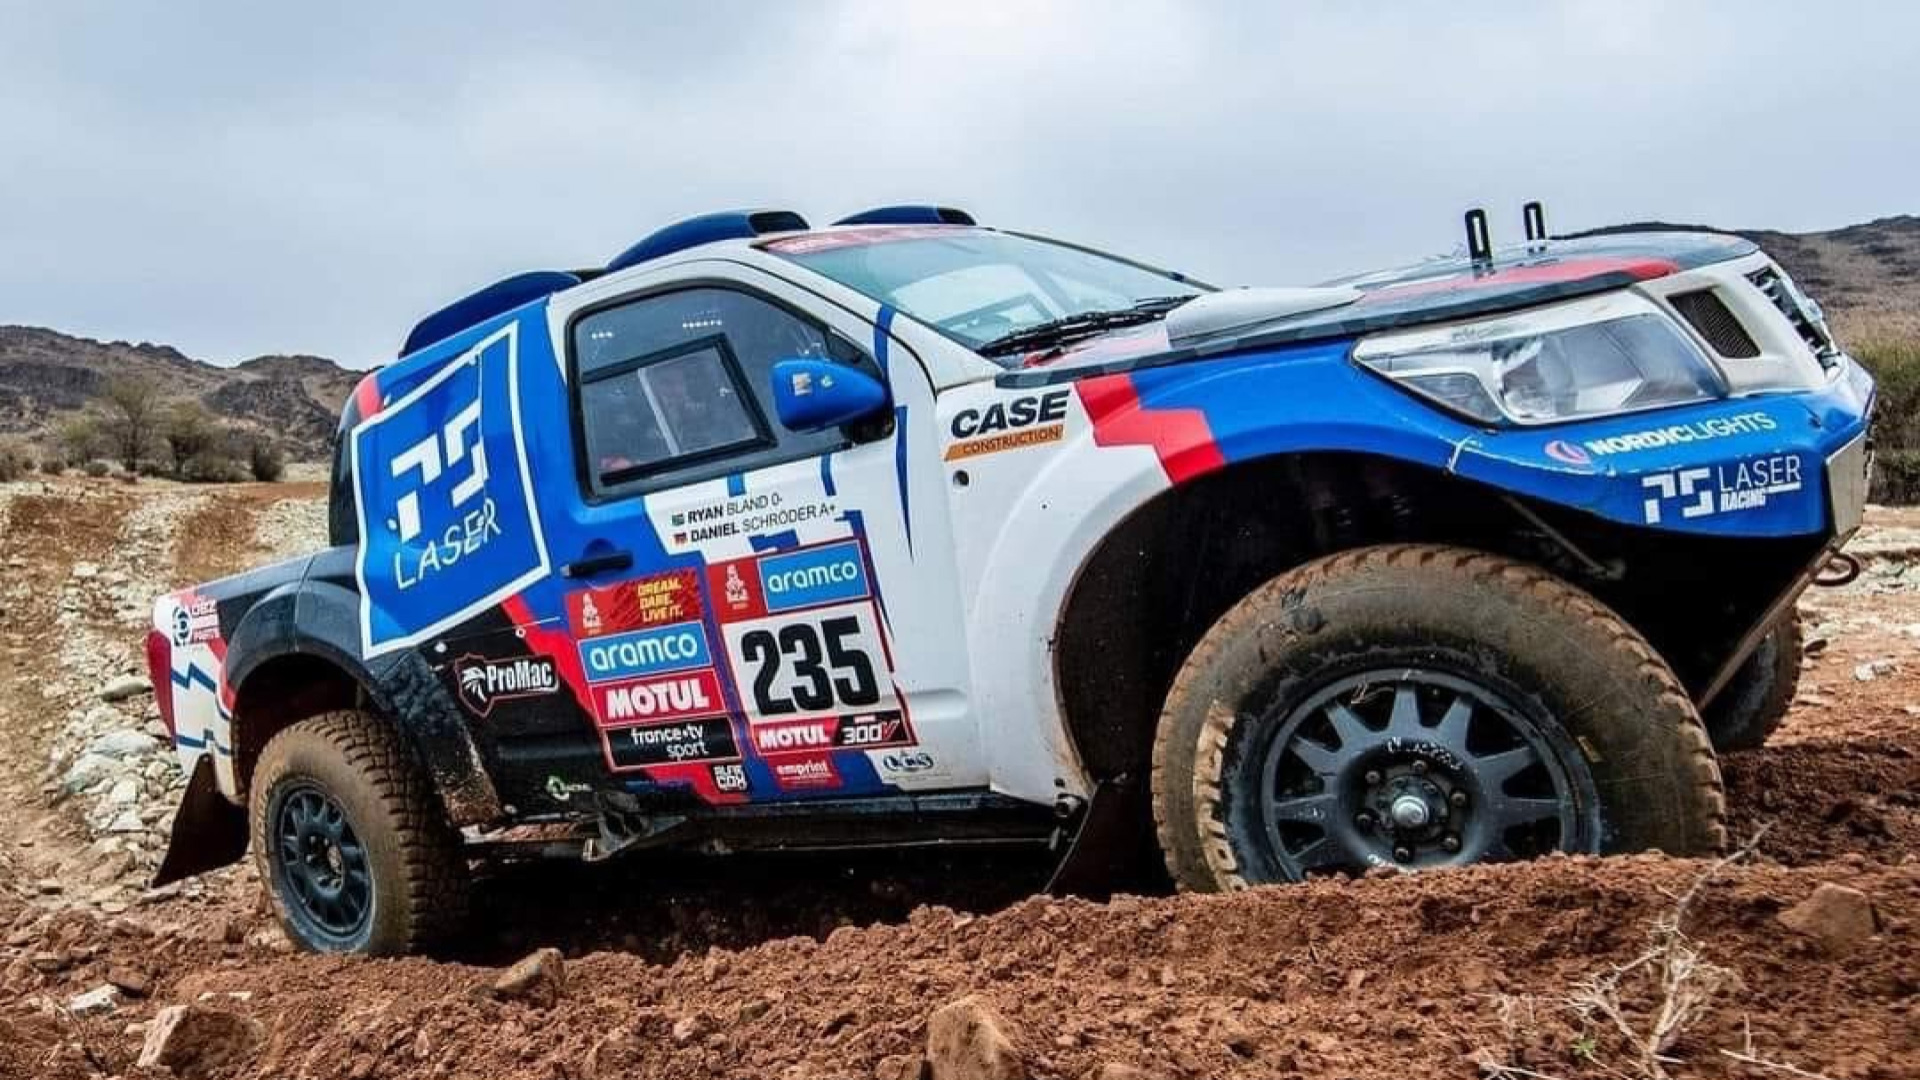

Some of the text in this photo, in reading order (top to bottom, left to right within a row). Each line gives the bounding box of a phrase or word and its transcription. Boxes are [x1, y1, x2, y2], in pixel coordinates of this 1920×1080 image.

[951, 390, 1070, 438] CASE
[963, 425, 1061, 454] CONSTRUCTION
[1585, 412, 1777, 455] NORDICLIGHTS
[1718, 454, 1802, 492] LASER
[688, 504, 723, 524] RYAN
[726, 495, 769, 516] BLAND
[1720, 487, 1767, 512] RACING
[394, 498, 502, 590] LASER
[691, 522, 740, 542] DANIEL
[768, 561, 858, 593] aramco
[642, 606, 668, 622] LIVE
[589, 633, 698, 671] aramco
[742, 615, 880, 716] 235
[486, 660, 552, 692] ProMac
[606, 678, 710, 719] MOTUL
[666, 741, 709, 762] sport
[760, 724, 831, 749] MOTUL
[777, 760, 828, 776] emprint
